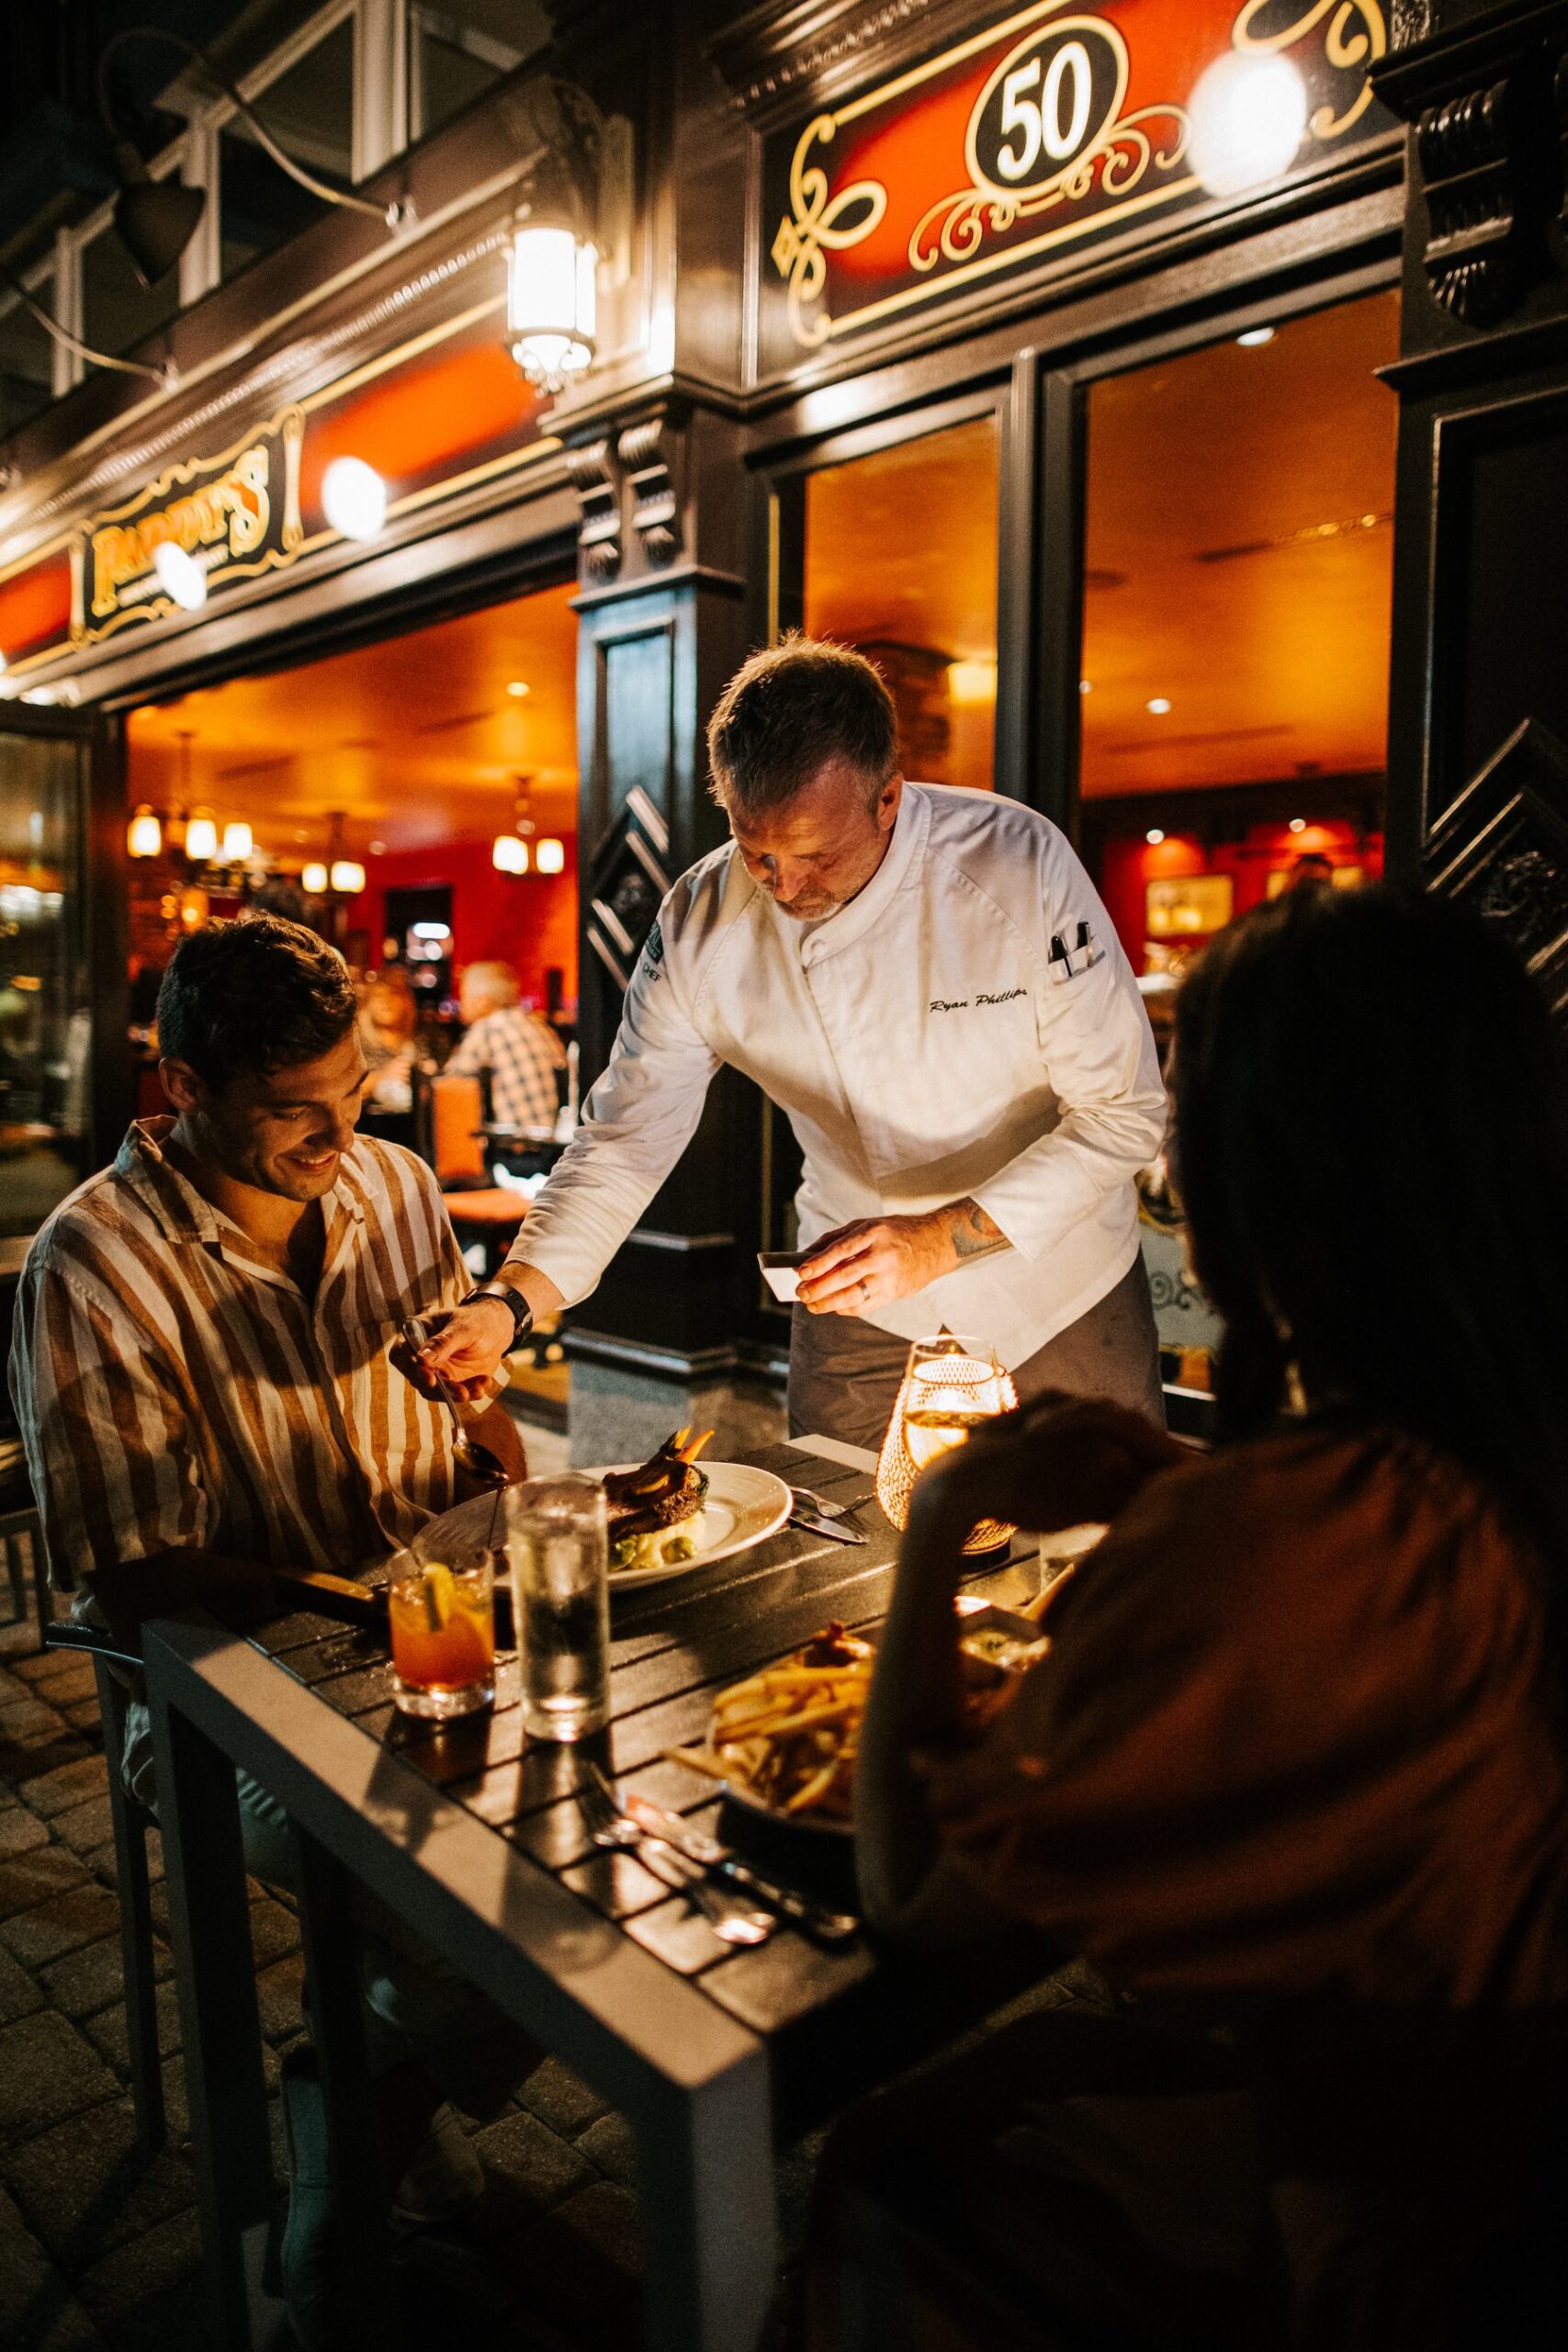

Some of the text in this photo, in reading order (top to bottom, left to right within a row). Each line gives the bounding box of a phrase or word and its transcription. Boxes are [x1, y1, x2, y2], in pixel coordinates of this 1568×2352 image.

[997, 40, 1092, 180] 50
[930, 987, 1028, 1012] Ryan Phillips
